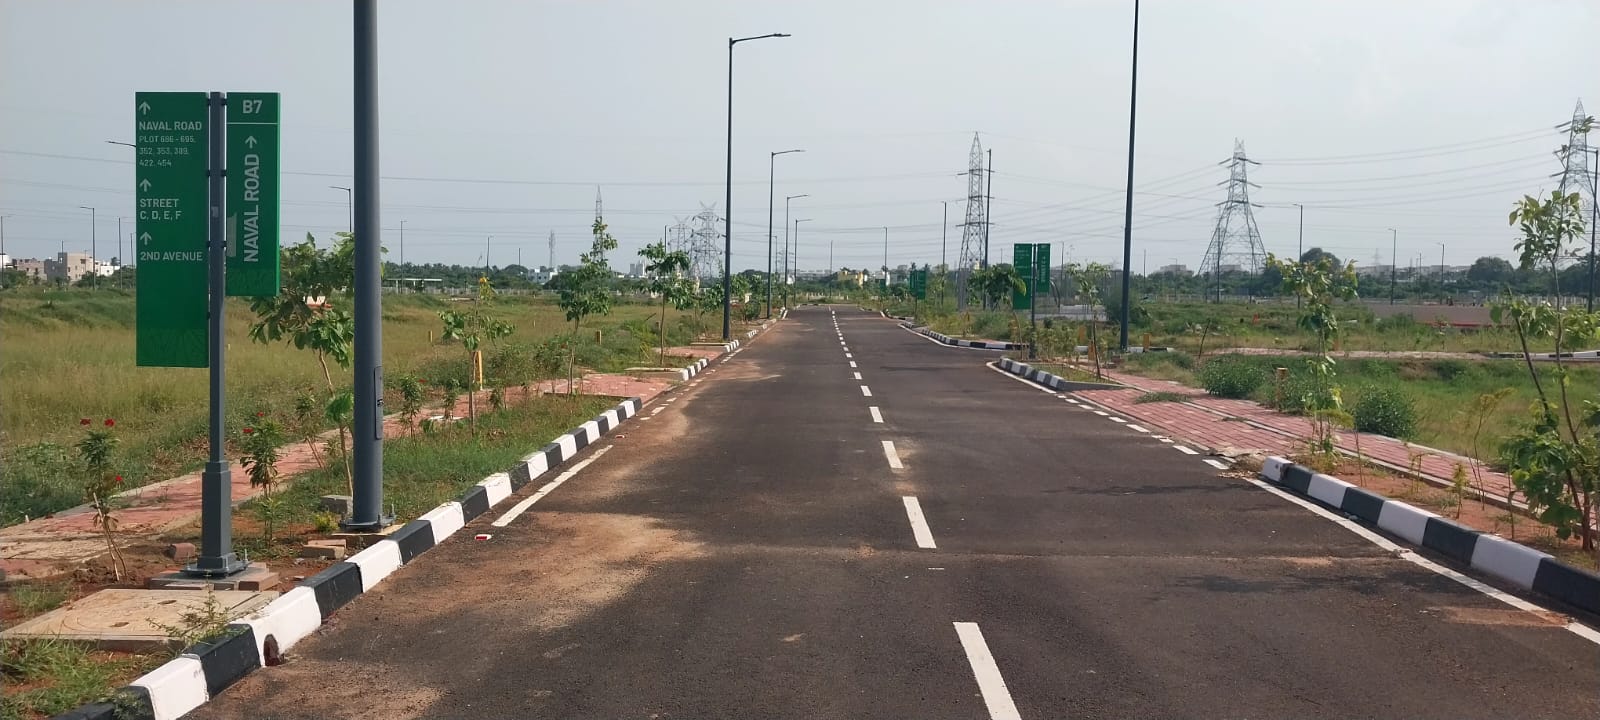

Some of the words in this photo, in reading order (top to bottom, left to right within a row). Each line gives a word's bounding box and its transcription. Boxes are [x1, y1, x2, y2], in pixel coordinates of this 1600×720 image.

[242, 99, 263, 114] B7
[139, 121, 172, 131] NAVAL
[174, 121, 202, 131] ROAD
[139, 135, 159, 143] PLOT
[244, 153, 260, 201] ROAD
[140, 198, 180, 208] STREET
[140, 210, 149, 220] C,
[151, 210, 161, 220] D,
[163, 210, 173, 220] E,
[175, 210, 182, 220] F
[243, 204, 259, 262] NAVAL
[140, 251, 160, 261] 2ND
[162, 251, 203, 261] AVENUE
